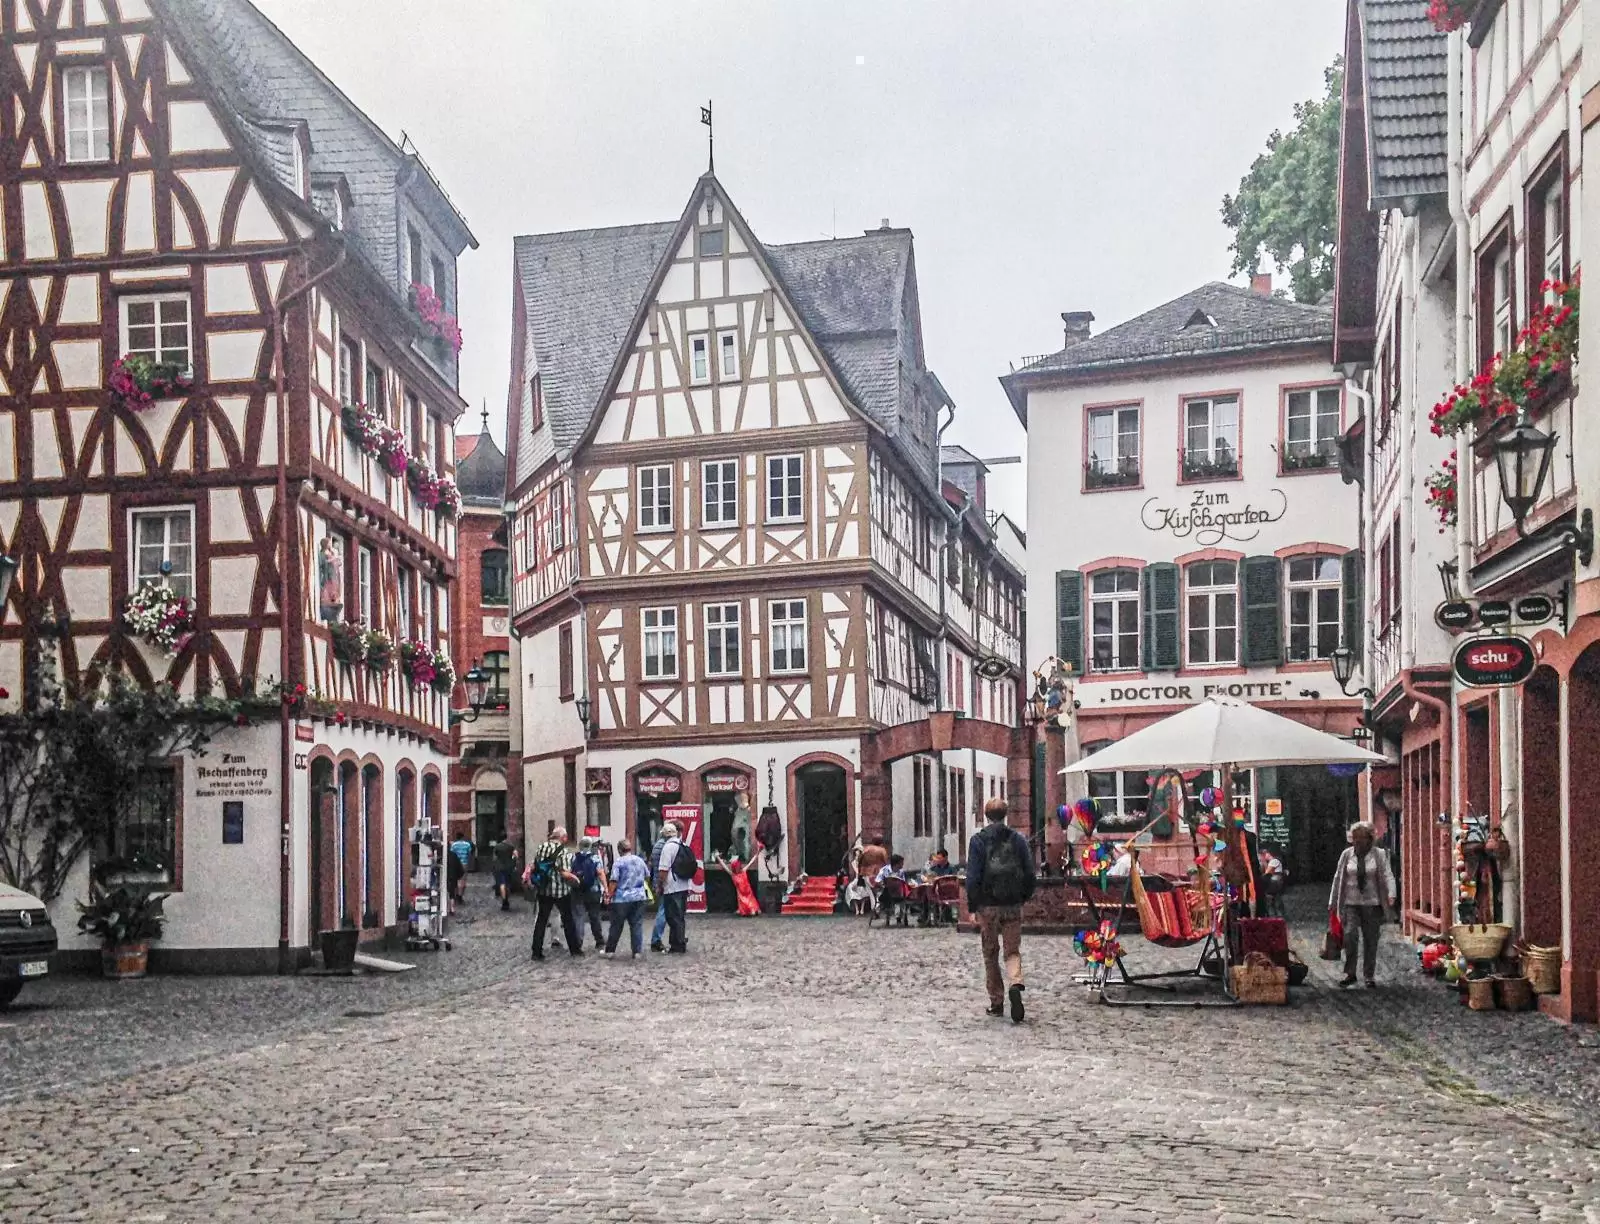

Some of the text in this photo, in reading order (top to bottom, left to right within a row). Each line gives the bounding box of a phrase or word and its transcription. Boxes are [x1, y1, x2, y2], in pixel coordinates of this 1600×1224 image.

[1190, 489, 1230, 508] Zum
[1471, 649, 1508, 664] schu
[222, 753, 246, 764] Zum
[640, 784, 665, 792] Verkauf
[708, 783, 734, 791] Verkauf
